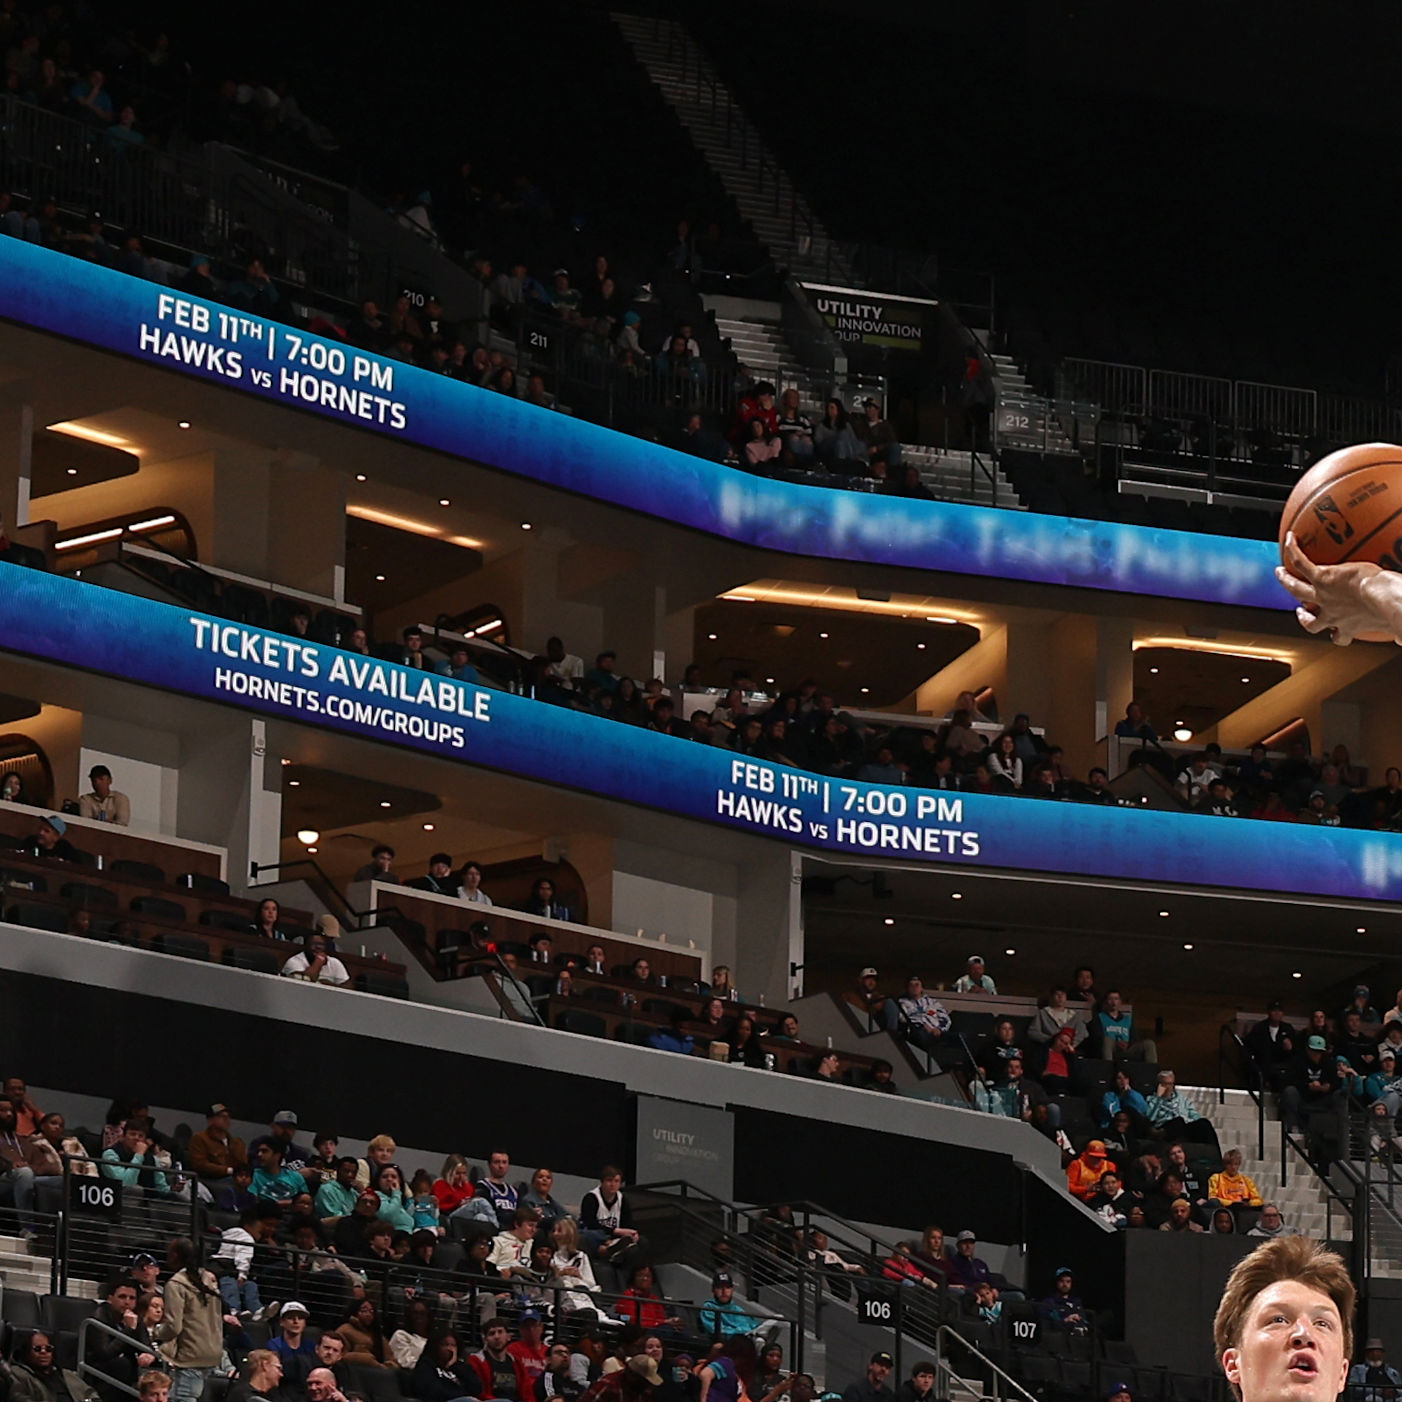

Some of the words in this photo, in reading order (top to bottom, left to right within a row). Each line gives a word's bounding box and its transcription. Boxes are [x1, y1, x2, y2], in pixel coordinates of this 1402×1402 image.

[816, 298, 884, 320] UTILITY
[837, 316, 922, 339] INNOVATION
[158, 293, 210, 333] FEB
[218, 311, 263, 343] 11TH
[284, 334, 346, 376] 7:00
[353, 356, 394, 392] PM
[529, 331, 549, 349] 211
[139, 323, 243, 379] HAWKS
[280, 367, 406, 430] HORNETS
[1005, 414, 1030, 429] 212
[190, 617, 319, 678] TICKETS
[328, 655, 492, 722] AVAILABLE
[214, 666, 465, 748] HORNETS.COM/GROUPS
[731, 759, 775, 793] FEB
[781, 772, 818, 800] 11TH
[840, 786, 907, 817] 7:00
[917, 795, 963, 823] PM
[717, 789, 802, 834] HAWKS
[836, 818, 980, 857] HORNETS
[652, 1128, 695, 1146] UTILITY
[78, 1184, 115, 1207] 106
[864, 1300, 891, 1321] 106
[1012, 1320, 1037, 1340] 107
